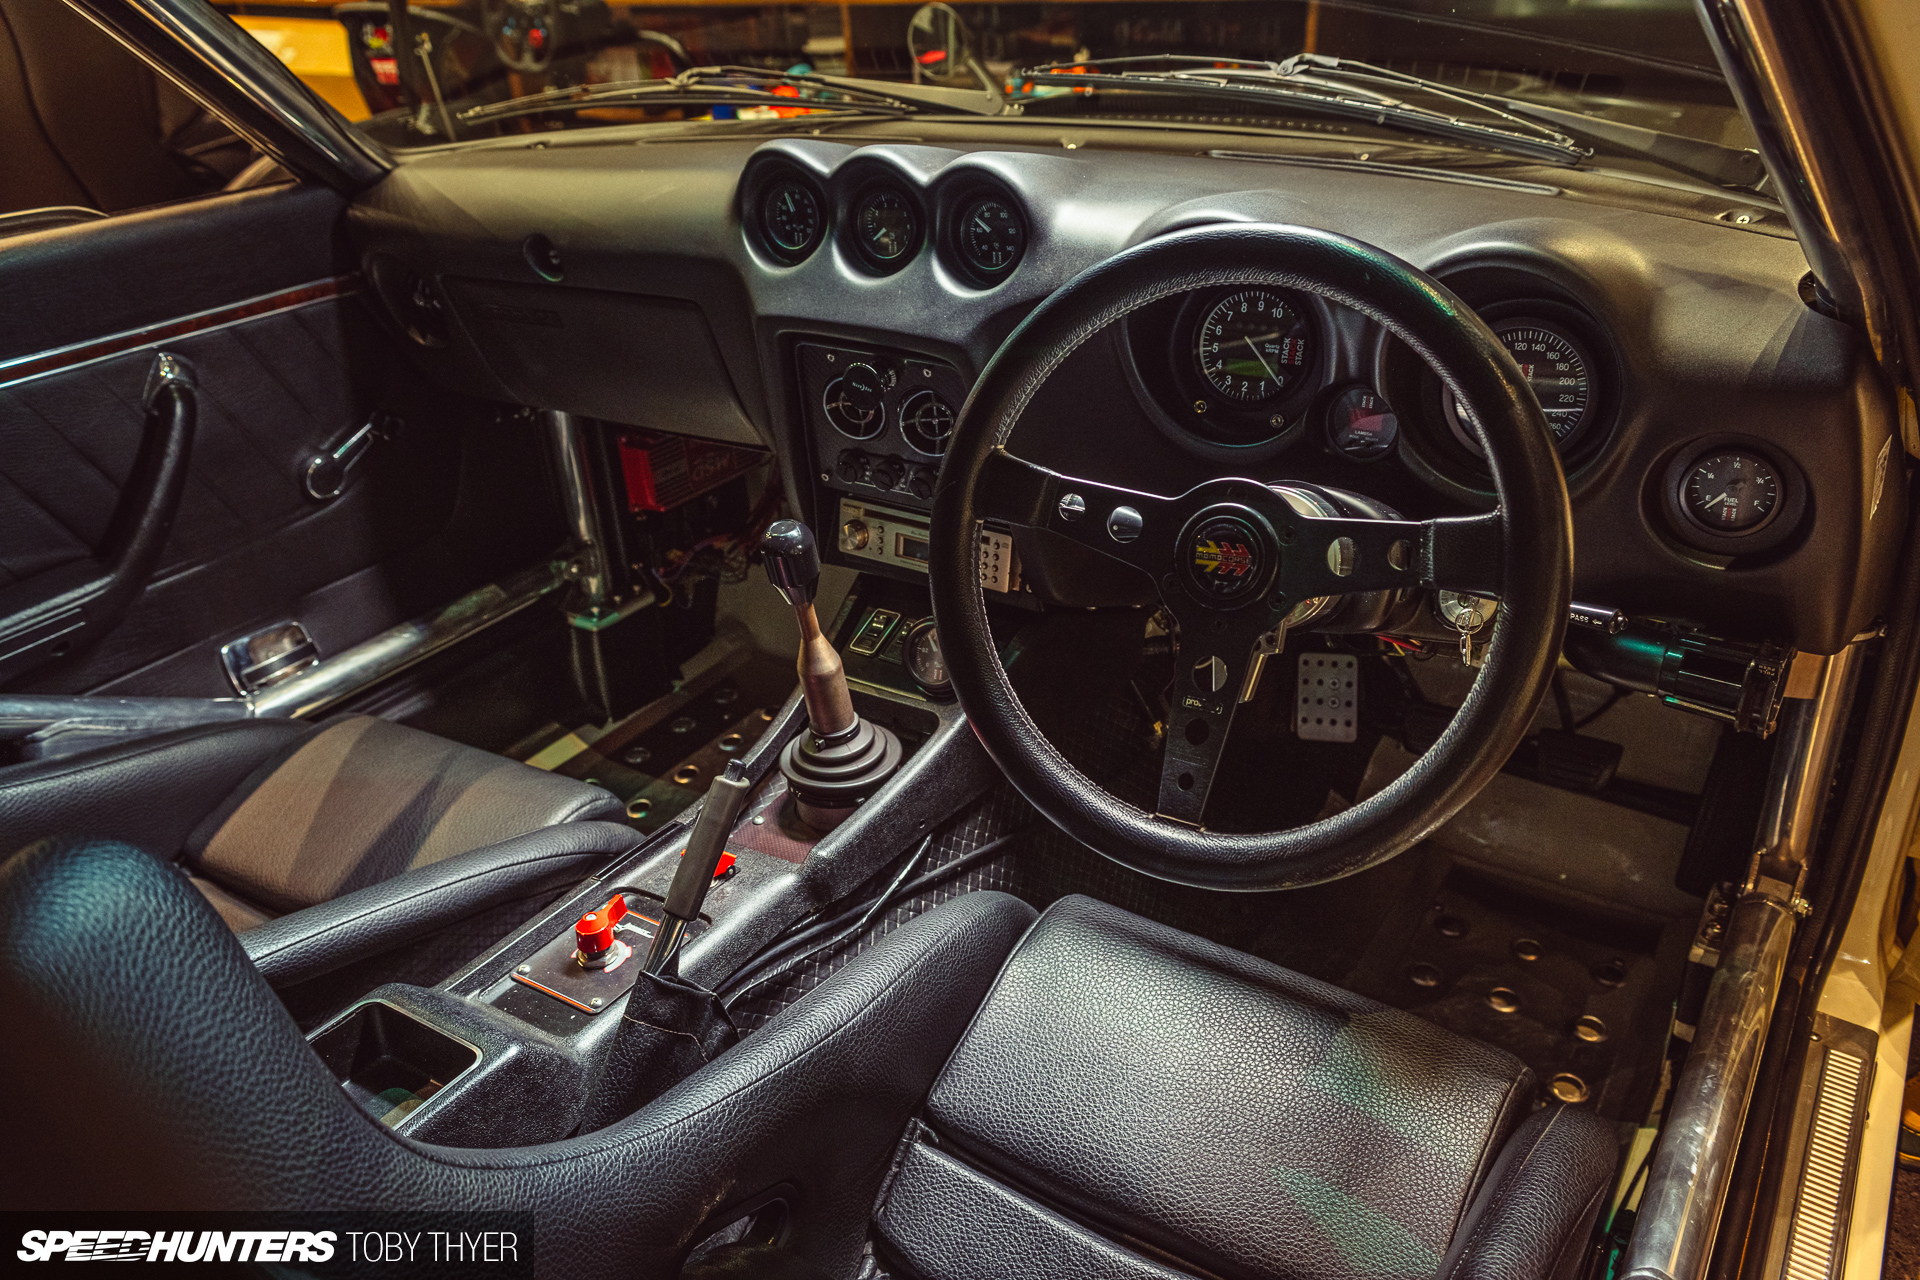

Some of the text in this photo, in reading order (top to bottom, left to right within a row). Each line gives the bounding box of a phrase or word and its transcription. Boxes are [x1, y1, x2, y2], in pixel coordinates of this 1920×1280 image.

[1241, 302, 1248, 313] 8
[1257, 301, 1265, 311] 9
[1227, 311, 1234, 321] 7
[1271, 308, 1283, 319] 10
[1215, 325, 1222, 335] 6
[1212, 342, 1219, 353] 5
[1280, 337, 1291, 364] STACK
[1288, 338, 1297, 365] STACK
[1514, 342, 1528, 351] 120
[1531, 343, 1546, 352] 140
[1294, 338, 1305, 366] STACK
[1546, 352, 1560, 360] 160
[1216, 359, 1223, 369] 4
[1556, 363, 1570, 371] 180
[1225, 375, 1232, 385] 3
[1559, 377, 1575, 386] 200
[1241, 381, 1248, 391] 2
[1259, 381, 1265, 391] 1
[1559, 394, 1575, 403] 220
[1569, 612, 1589, 623] PASS
